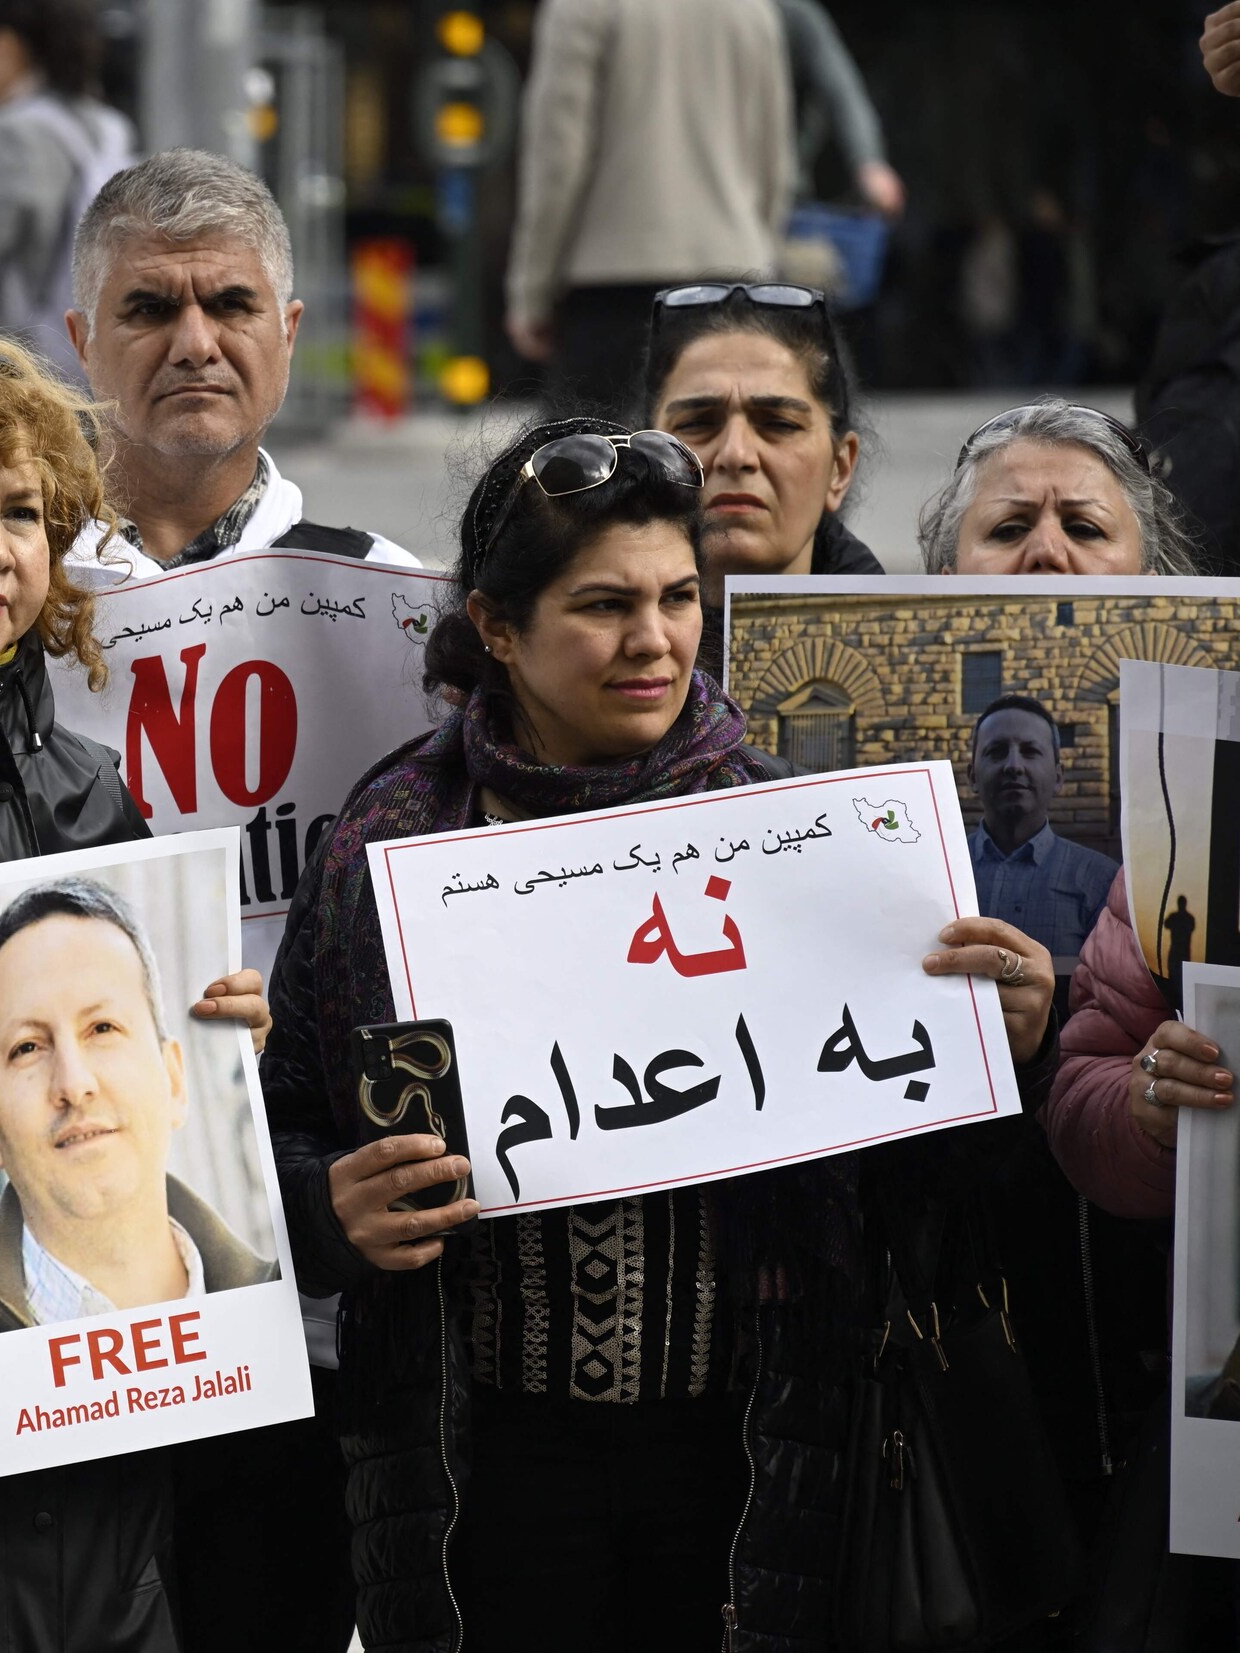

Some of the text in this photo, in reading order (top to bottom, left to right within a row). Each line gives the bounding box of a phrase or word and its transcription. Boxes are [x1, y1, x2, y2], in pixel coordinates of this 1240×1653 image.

[179, 599, 213, 625] یک
[219, 596, 244, 625] هم
[256, 592, 290, 616] من
[300, 592, 366, 622] کمپین
[126, 643, 298, 818] NO
[440, 813, 833, 908] کمپین من هم یک مسیحی هستم
[626, 874, 748, 978] نه
[495, 1002, 936, 1203] به اعدام
[48, 1310, 208, 1389] FREE
[15, 1365, 253, 1436] Ahamad Reza Jalali
